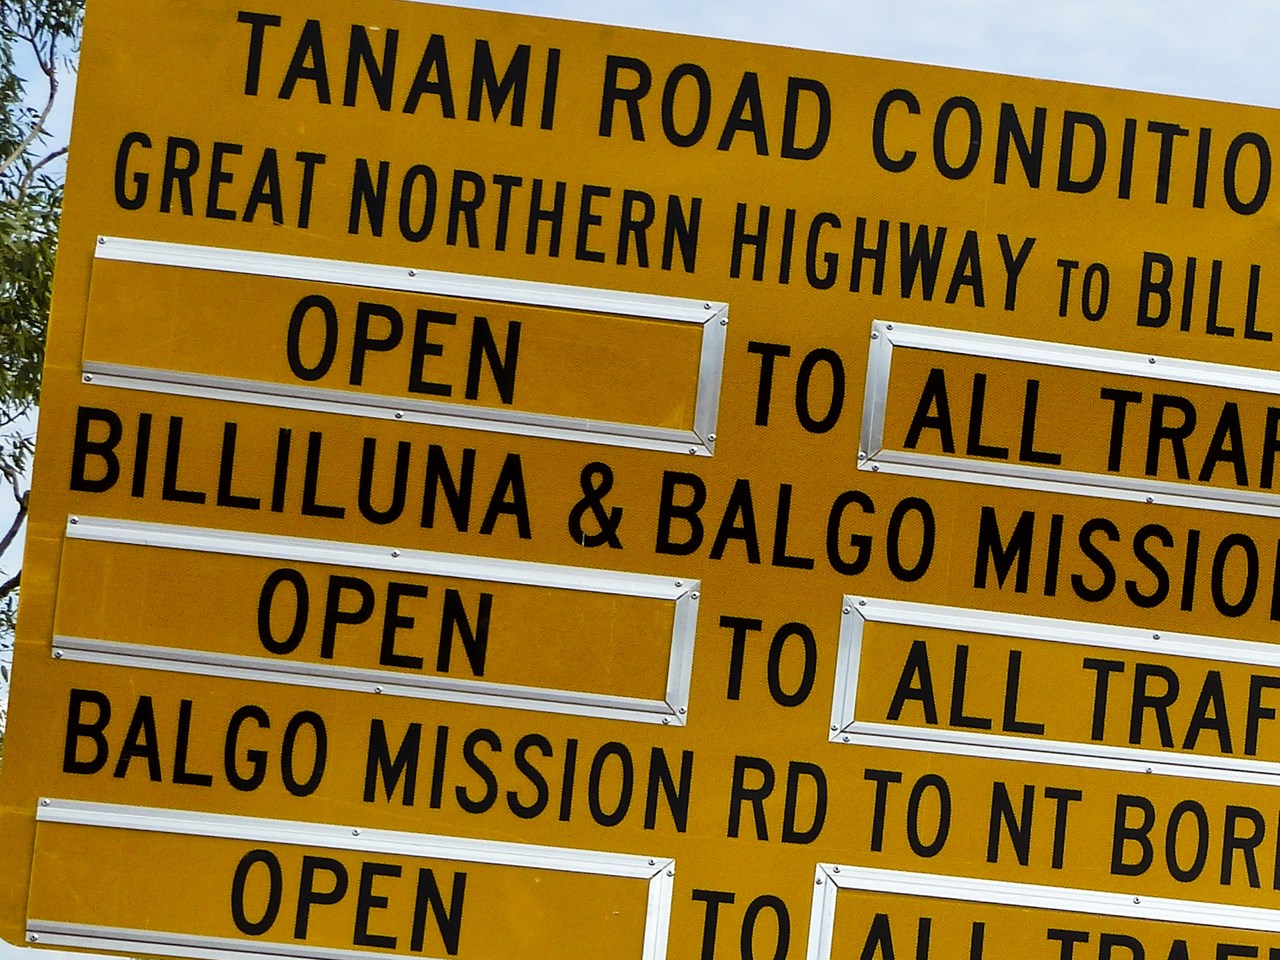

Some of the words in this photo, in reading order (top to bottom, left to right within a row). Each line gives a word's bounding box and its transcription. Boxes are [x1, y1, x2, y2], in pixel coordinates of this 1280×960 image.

[236, 10, 561, 131] TANAMI
[598, 54, 832, 161] ROAD
[114, 131, 327, 230] GREAT
[347, 157, 703, 274] NORTHERN
[729, 202, 1037, 312] HIGHWAY
[1056, 258, 1110, 322] TO
[286, 294, 522, 405] OPEN
[746, 340, 846, 435] TO
[902, 367, 1062, 466] ALL
[68, 405, 532, 540] BILLILUNA
[567, 461, 624, 550] &
[654, 470, 936, 583] BALGO
[257, 567, 494, 677] OPEN
[719, 615, 818, 708] TO
[885, 639, 1045, 736] ALL
[62, 687, 328, 798] BALGO
[362, 718, 694, 833] MISSION
[726, 754, 828, 845] RD
[863, 768, 952, 858] TO
[986, 781, 1083, 870] NT
[230, 848, 467, 956] OPEN
